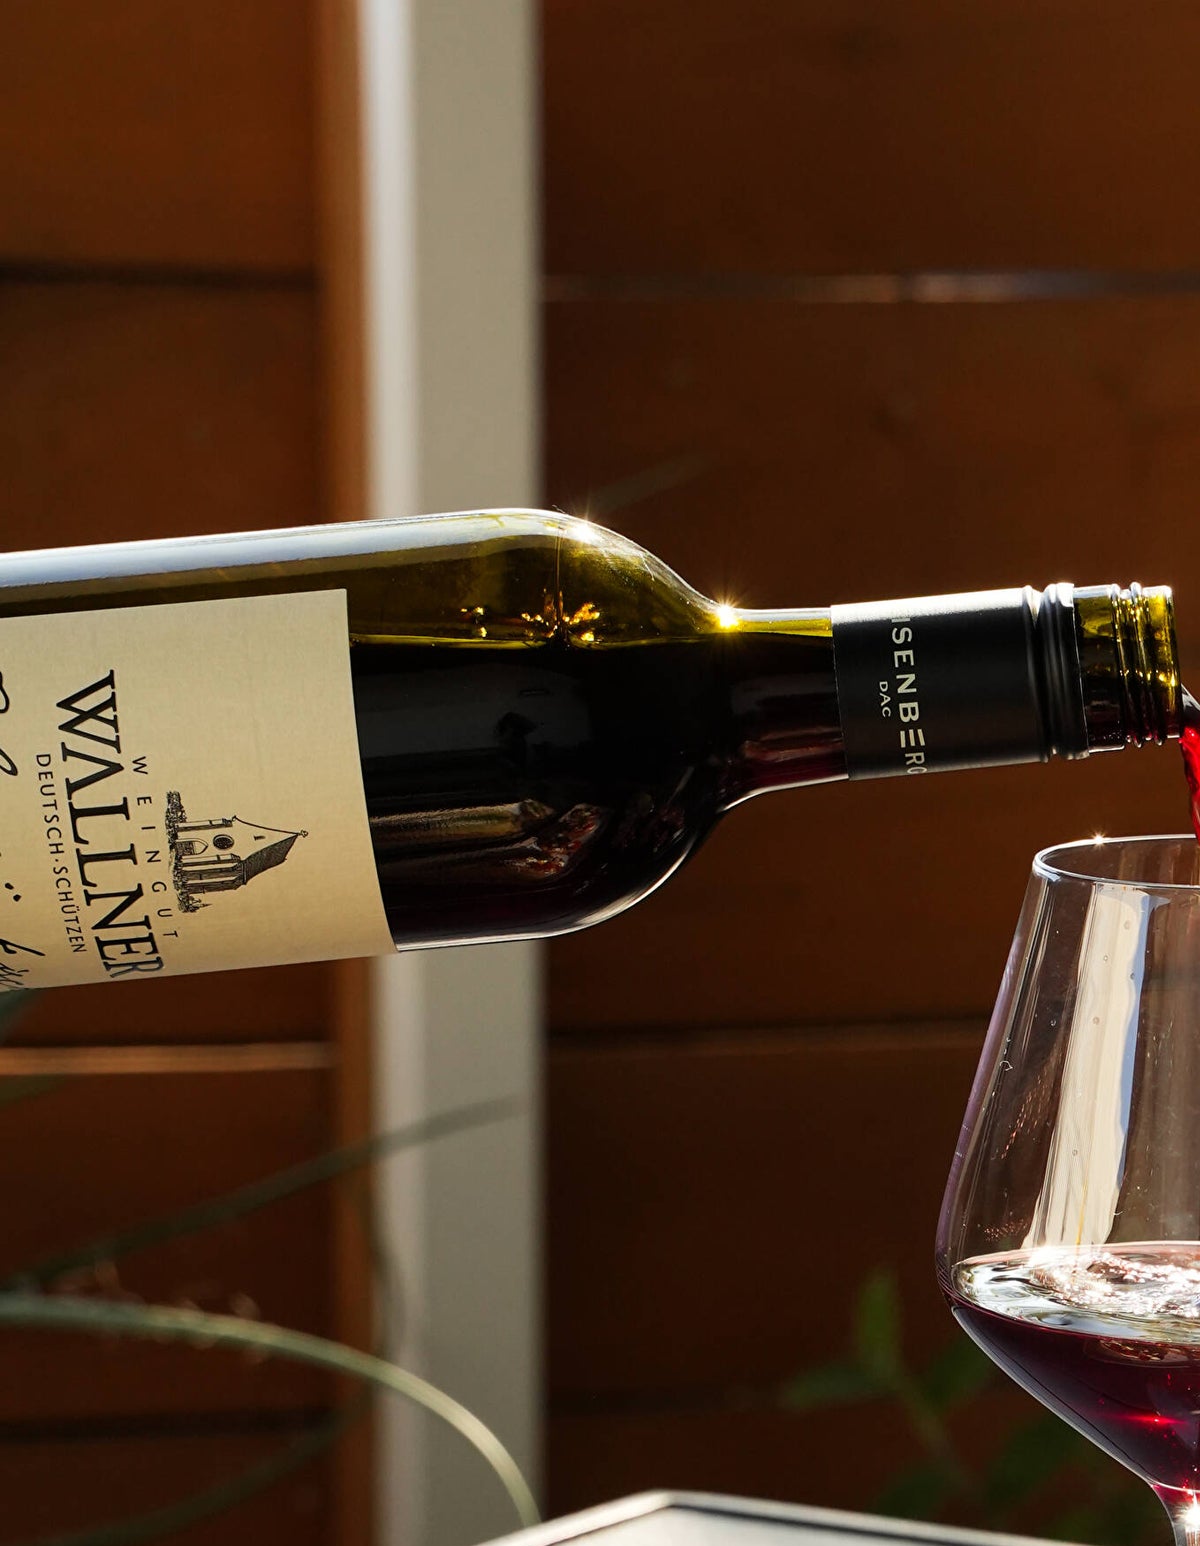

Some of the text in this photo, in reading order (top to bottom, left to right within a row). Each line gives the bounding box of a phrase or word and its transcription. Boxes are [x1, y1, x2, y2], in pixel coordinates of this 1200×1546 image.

[879, 681, 891, 718] DAC
[56, 668, 165, 979] WALLNER
[131, 754, 178, 938] WEINGUT
